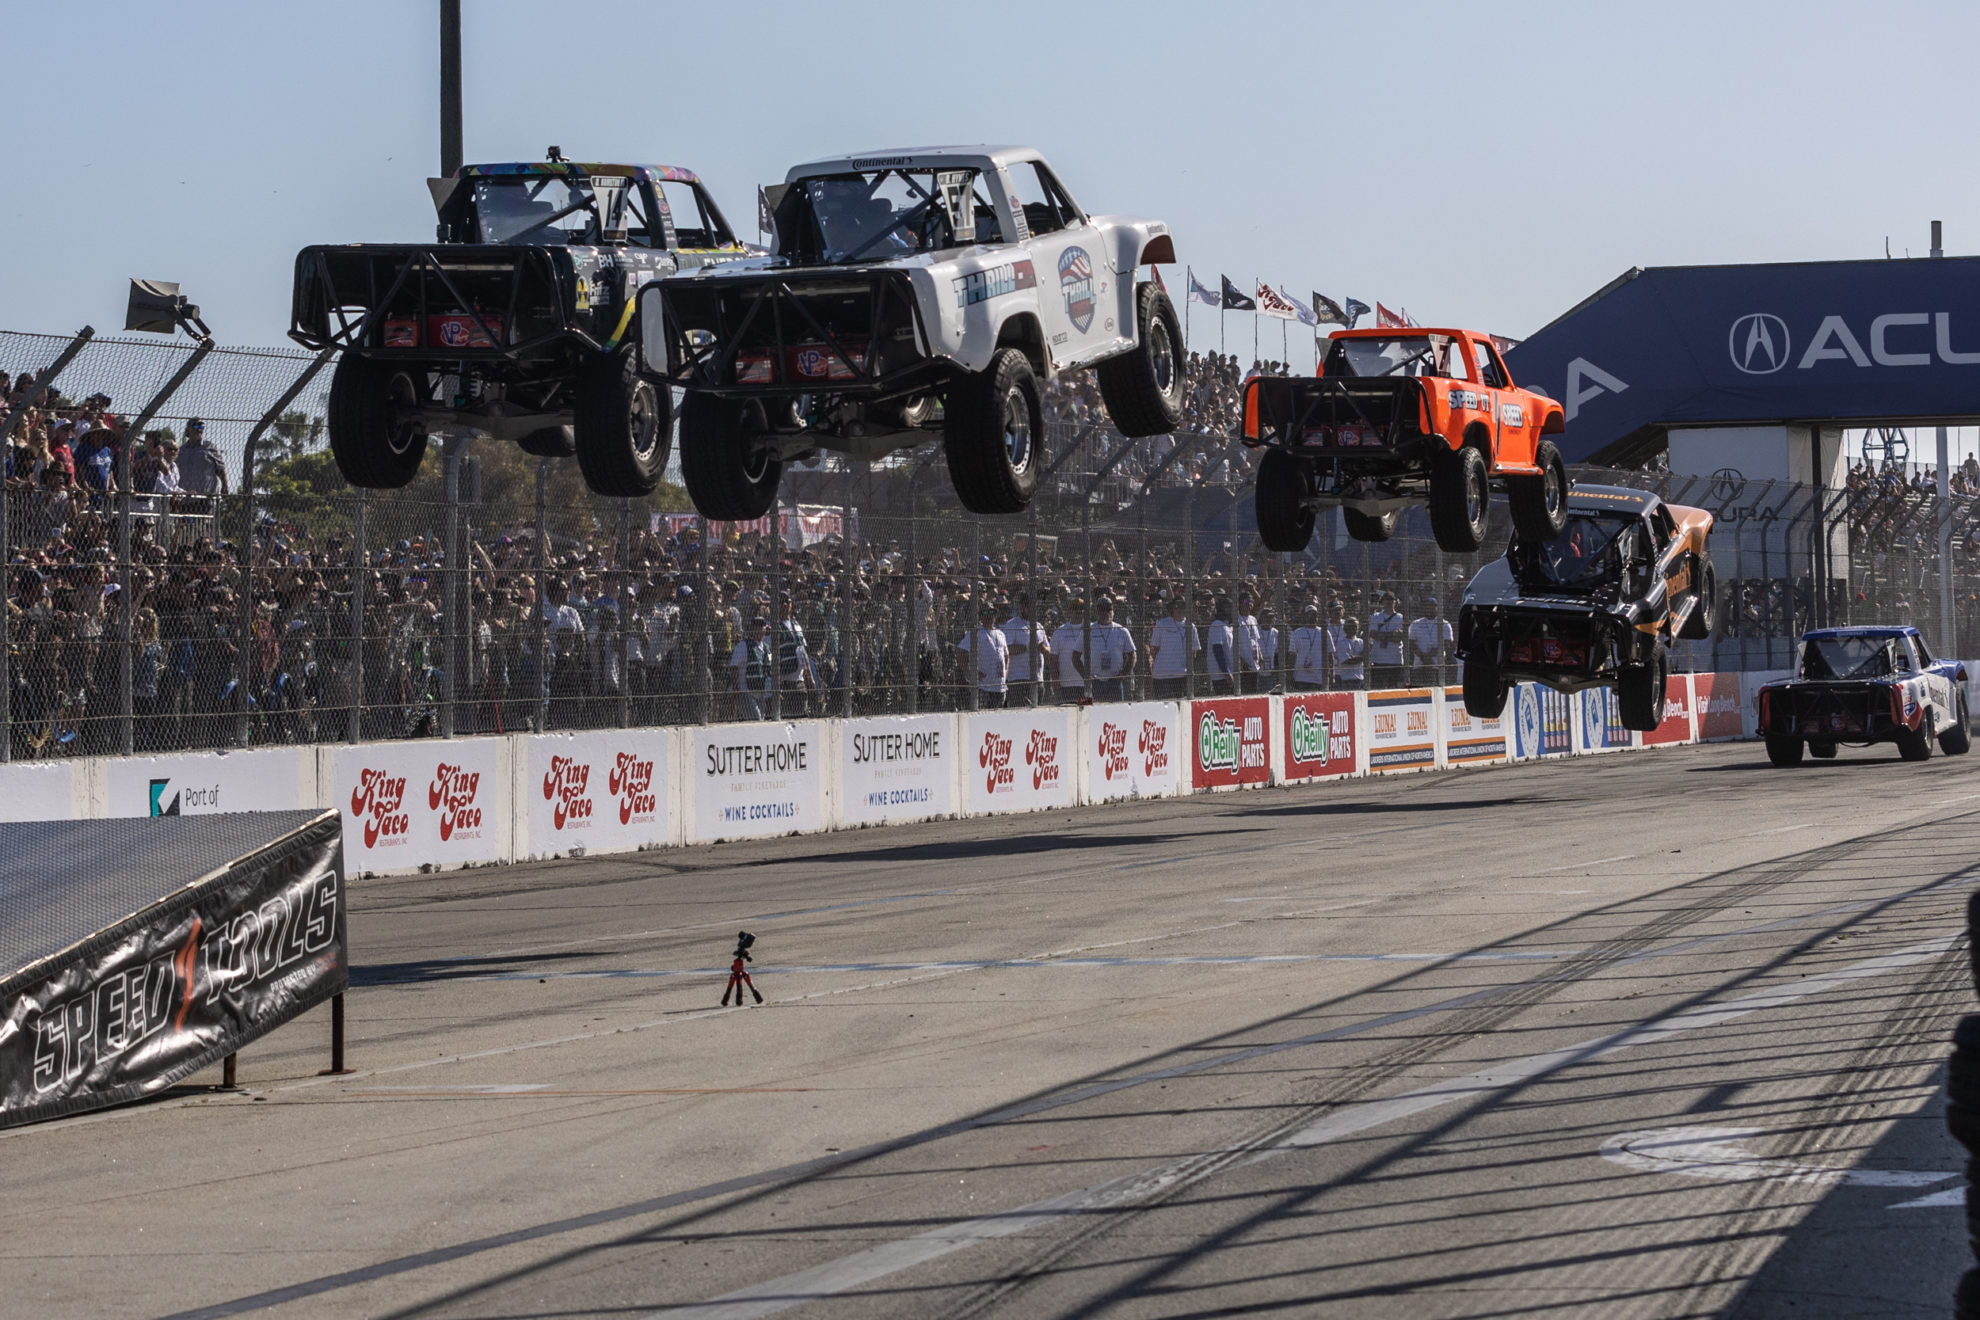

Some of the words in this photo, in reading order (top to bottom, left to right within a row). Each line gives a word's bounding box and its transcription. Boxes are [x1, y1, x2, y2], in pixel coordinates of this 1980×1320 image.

[852, 156, 904, 170] Continental
[605, 189, 623, 228] 14
[952, 263, 1016, 307] THRILL
[1062, 277, 1097, 314] THRILL
[1448, 390, 1478, 410] SPEED
[1502, 403, 1523, 427] SPEED
[1568, 491, 1630, 501] tinental
[1099, 722, 1127, 757] King
[1139, 720, 1166, 753] King
[1243, 716, 1263, 742] AUTO
[1291, 705, 1330, 767] O'Reilly
[1331, 710, 1349, 735] AUTO
[707, 743, 763, 776] SUTTER
[766, 742, 807, 771] HOME
[854, 733, 902, 762] SUTTER
[905, 731, 940, 759] HOME
[980, 731, 1012, 768] King
[1026, 729, 1057, 765] King
[1145, 743, 1168, 777] Taco
[1199, 710, 1242, 775] O'Reilly
[1241, 742, 1265, 768] PARTS
[1330, 735, 1351, 760] PARTS
[543, 755, 590, 800] King
[609, 752, 653, 796] King
[987, 756, 1014, 794] Taco
[1033, 755, 1059, 790] Taco
[1105, 746, 1128, 781] Taco
[185, 787, 207, 807] Port
[208, 784, 219, 807] of
[351, 768, 406, 817] King
[429, 762, 480, 810] King
[620, 781, 656, 825] Taco
[868, 791, 888, 806] WINE
[890, 788, 929, 805] COCKTAILS
[364, 801, 408, 849] Taco
[440, 795, 482, 841] Taco
[554, 786, 592, 830] Taco
[724, 804, 746, 821] WINE
[750, 802, 795, 820] COCKTAILS
[33, 949, 176, 1093] SPEED
[200, 870, 337, 1005] TOOLS
